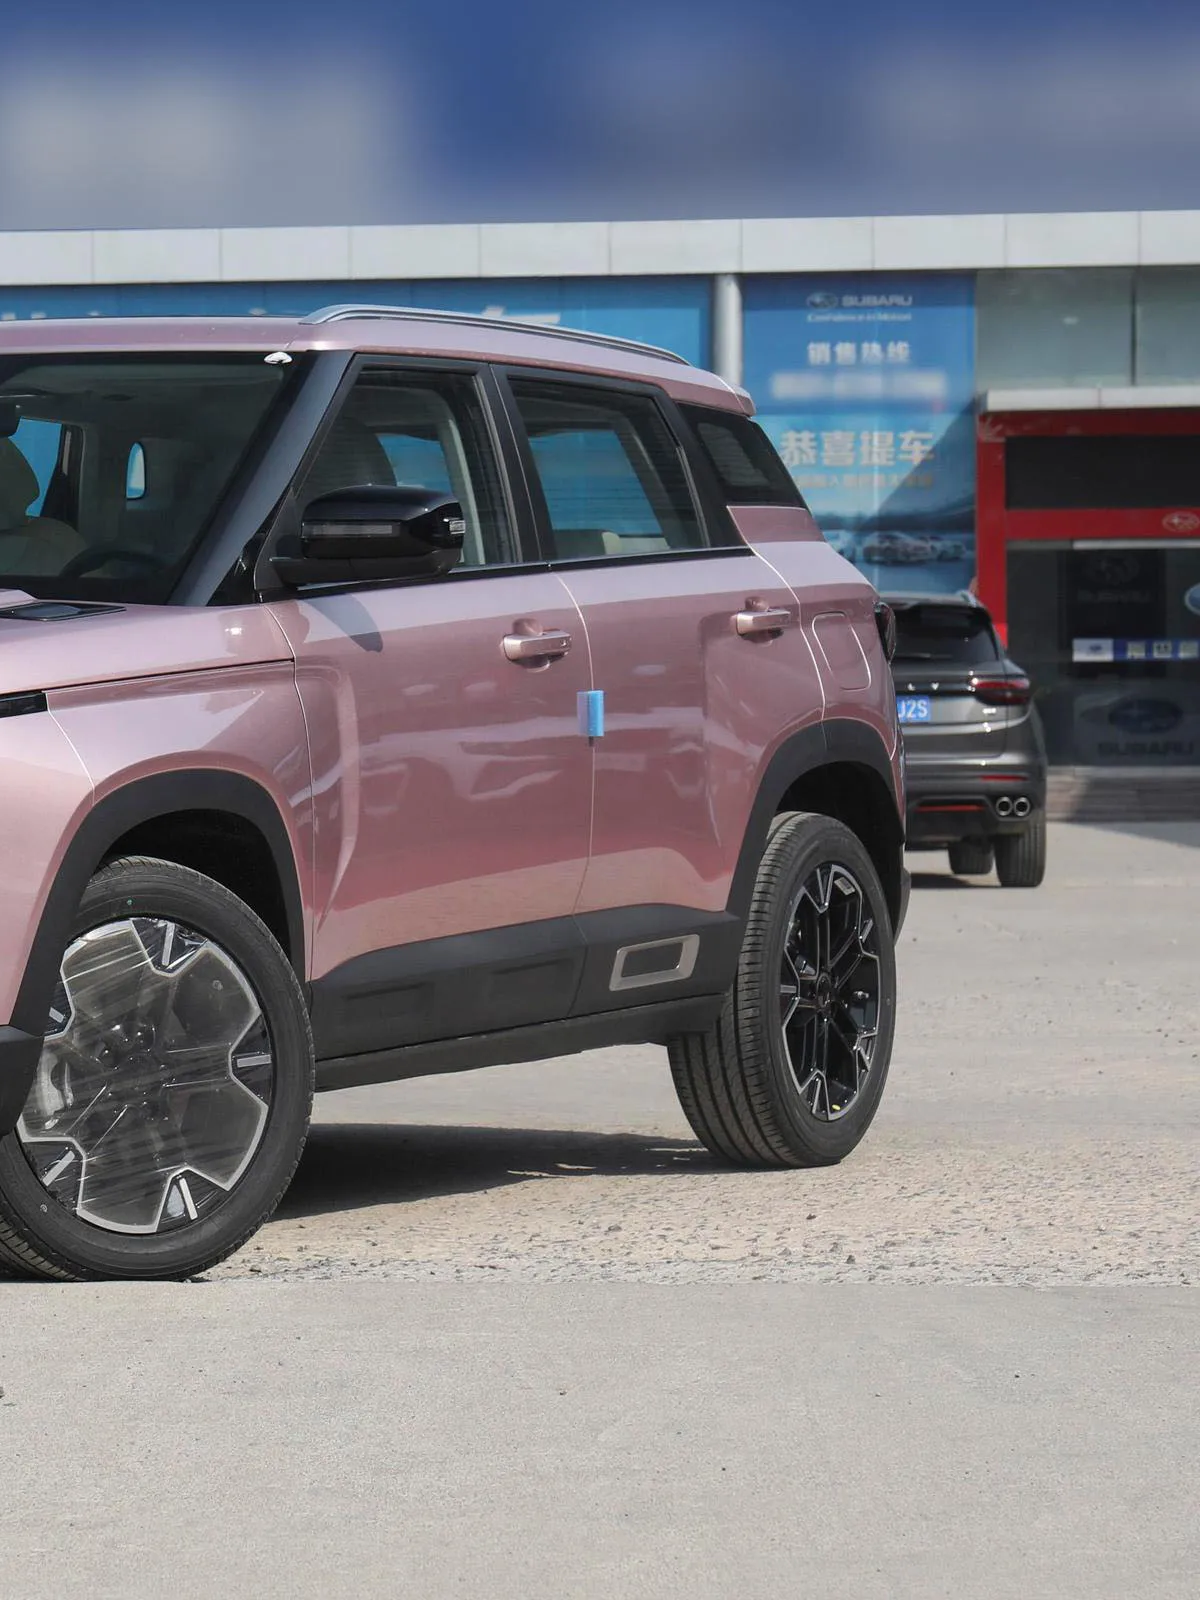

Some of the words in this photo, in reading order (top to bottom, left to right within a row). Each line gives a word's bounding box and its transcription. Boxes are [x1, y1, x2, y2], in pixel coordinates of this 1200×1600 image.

[842, 294, 913, 307] SUBARU
[807, 340, 911, 366] 销售热线
[780, 430, 935, 467] 恭喜提车
